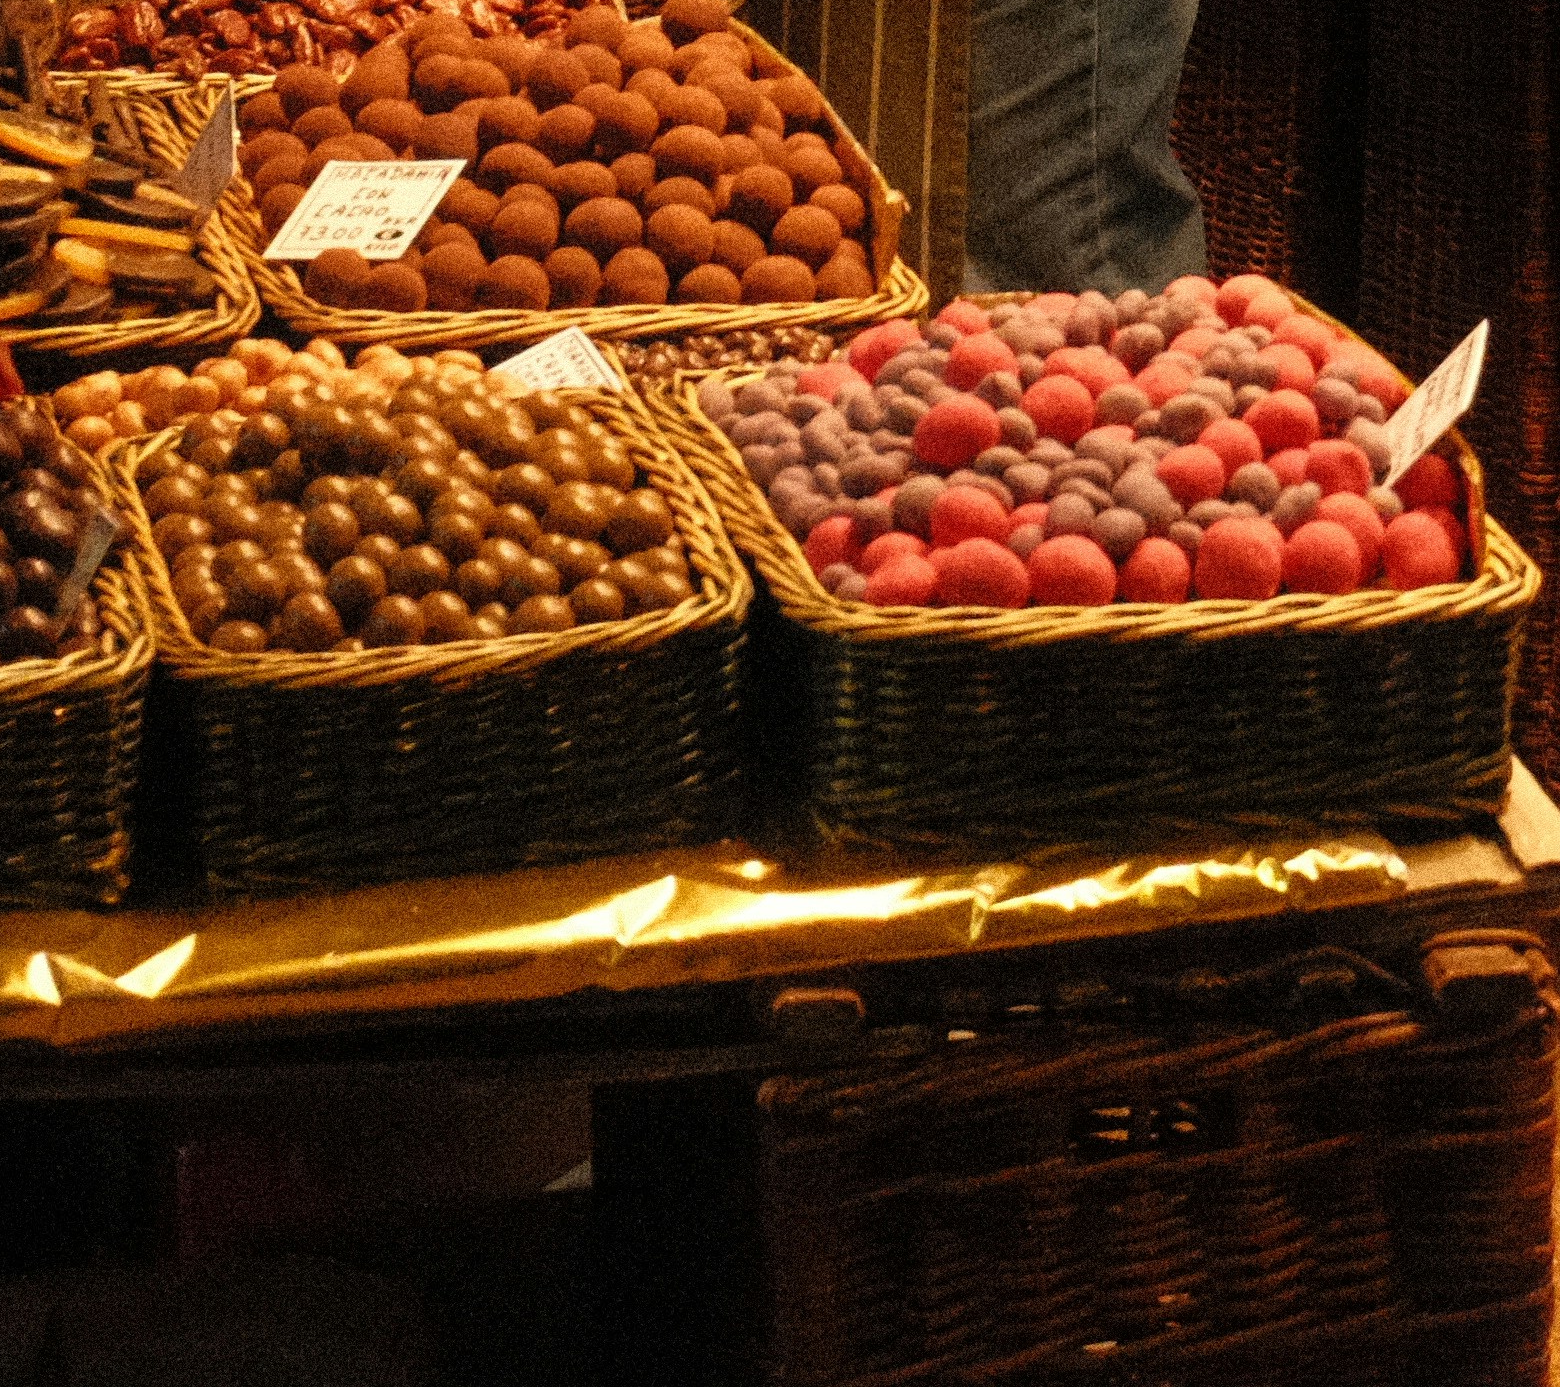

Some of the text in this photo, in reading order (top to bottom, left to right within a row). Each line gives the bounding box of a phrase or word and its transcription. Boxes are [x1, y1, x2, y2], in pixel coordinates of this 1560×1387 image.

[332, 166, 450, 182] MACADAMIA
[351, 186, 396, 201] CON
[313, 205, 391, 219] CACAO
